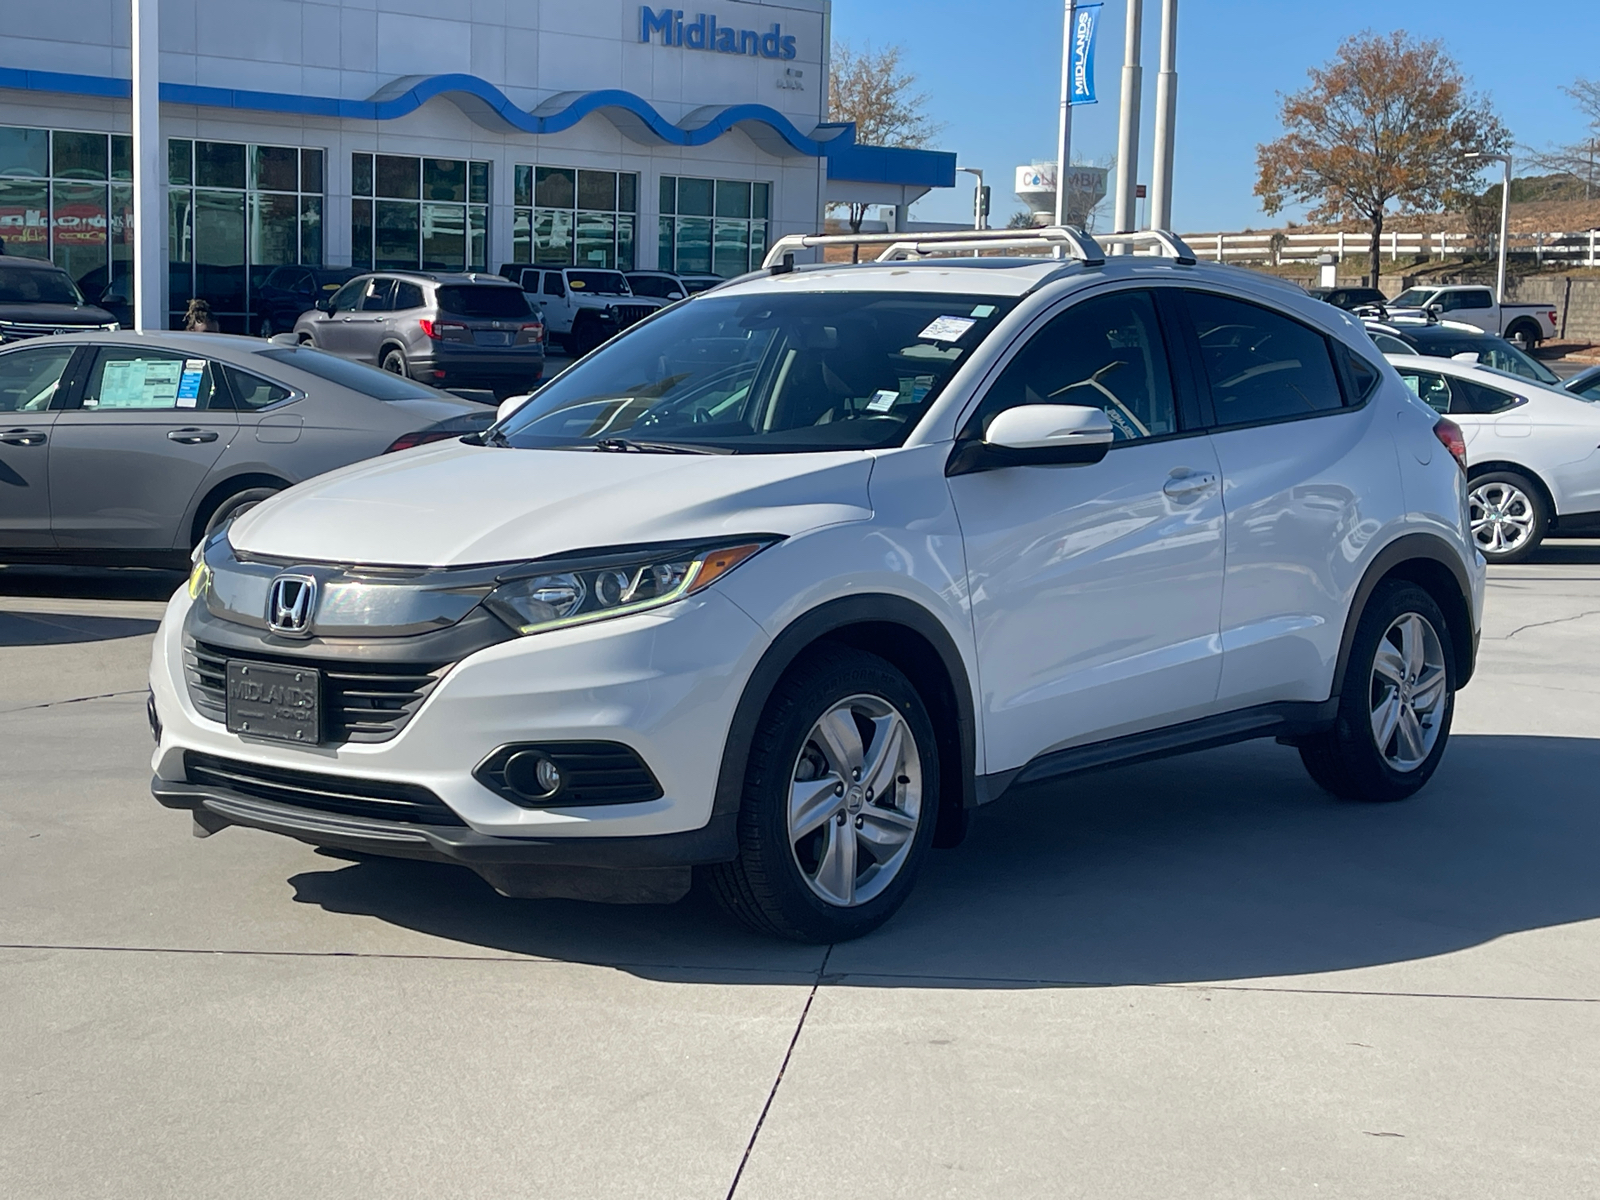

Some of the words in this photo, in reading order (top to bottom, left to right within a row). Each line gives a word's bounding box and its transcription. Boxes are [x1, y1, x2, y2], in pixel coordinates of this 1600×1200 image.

[639, 5, 797, 60] Midlands
[1075, 11, 1089, 95] MIDLANDS
[229, 679, 315, 710] MIDLANDS
